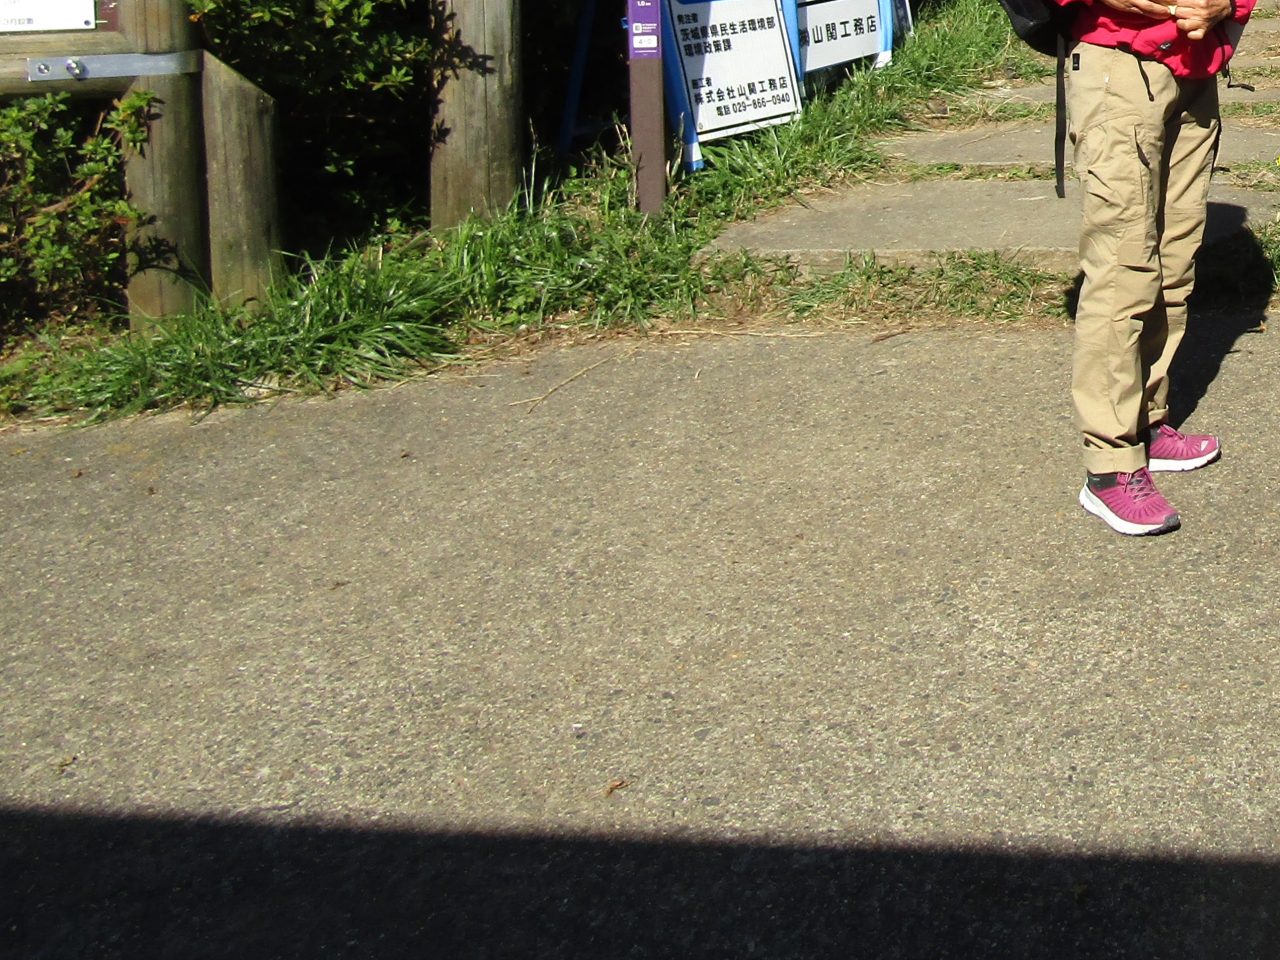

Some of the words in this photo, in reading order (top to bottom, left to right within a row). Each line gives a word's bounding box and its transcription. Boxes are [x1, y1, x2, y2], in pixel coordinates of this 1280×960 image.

[680, 16, 776, 42] 茨城県県民生活環境部
[684, 38, 732, 58] 環境政策課
[694, 76, 788, 105] 株式会社山関工務店
[732, 93, 791, 114] 029-866-0940
